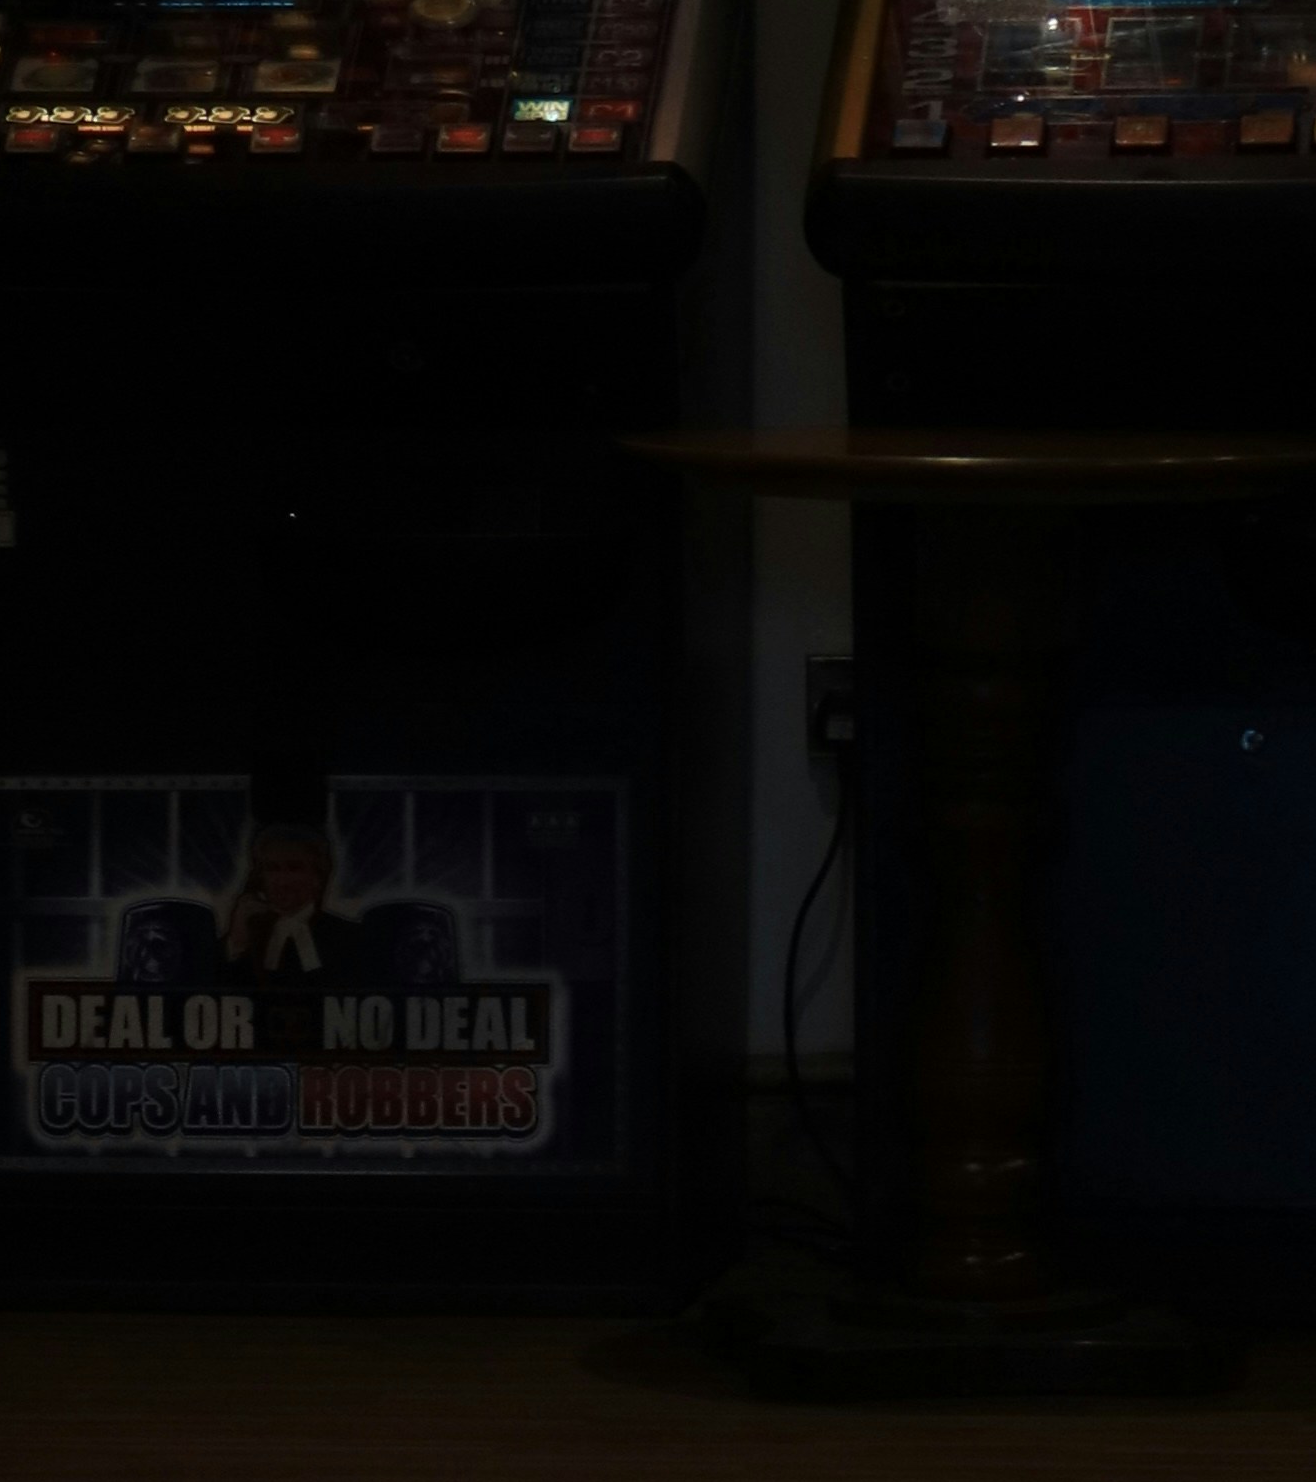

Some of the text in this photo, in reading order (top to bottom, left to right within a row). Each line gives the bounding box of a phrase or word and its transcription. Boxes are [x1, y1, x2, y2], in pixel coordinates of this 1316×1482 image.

[42, 994, 536, 1050] DEAL OR NO DEAL
[40, 1062, 538, 1132] COPS AND ROBBERS
